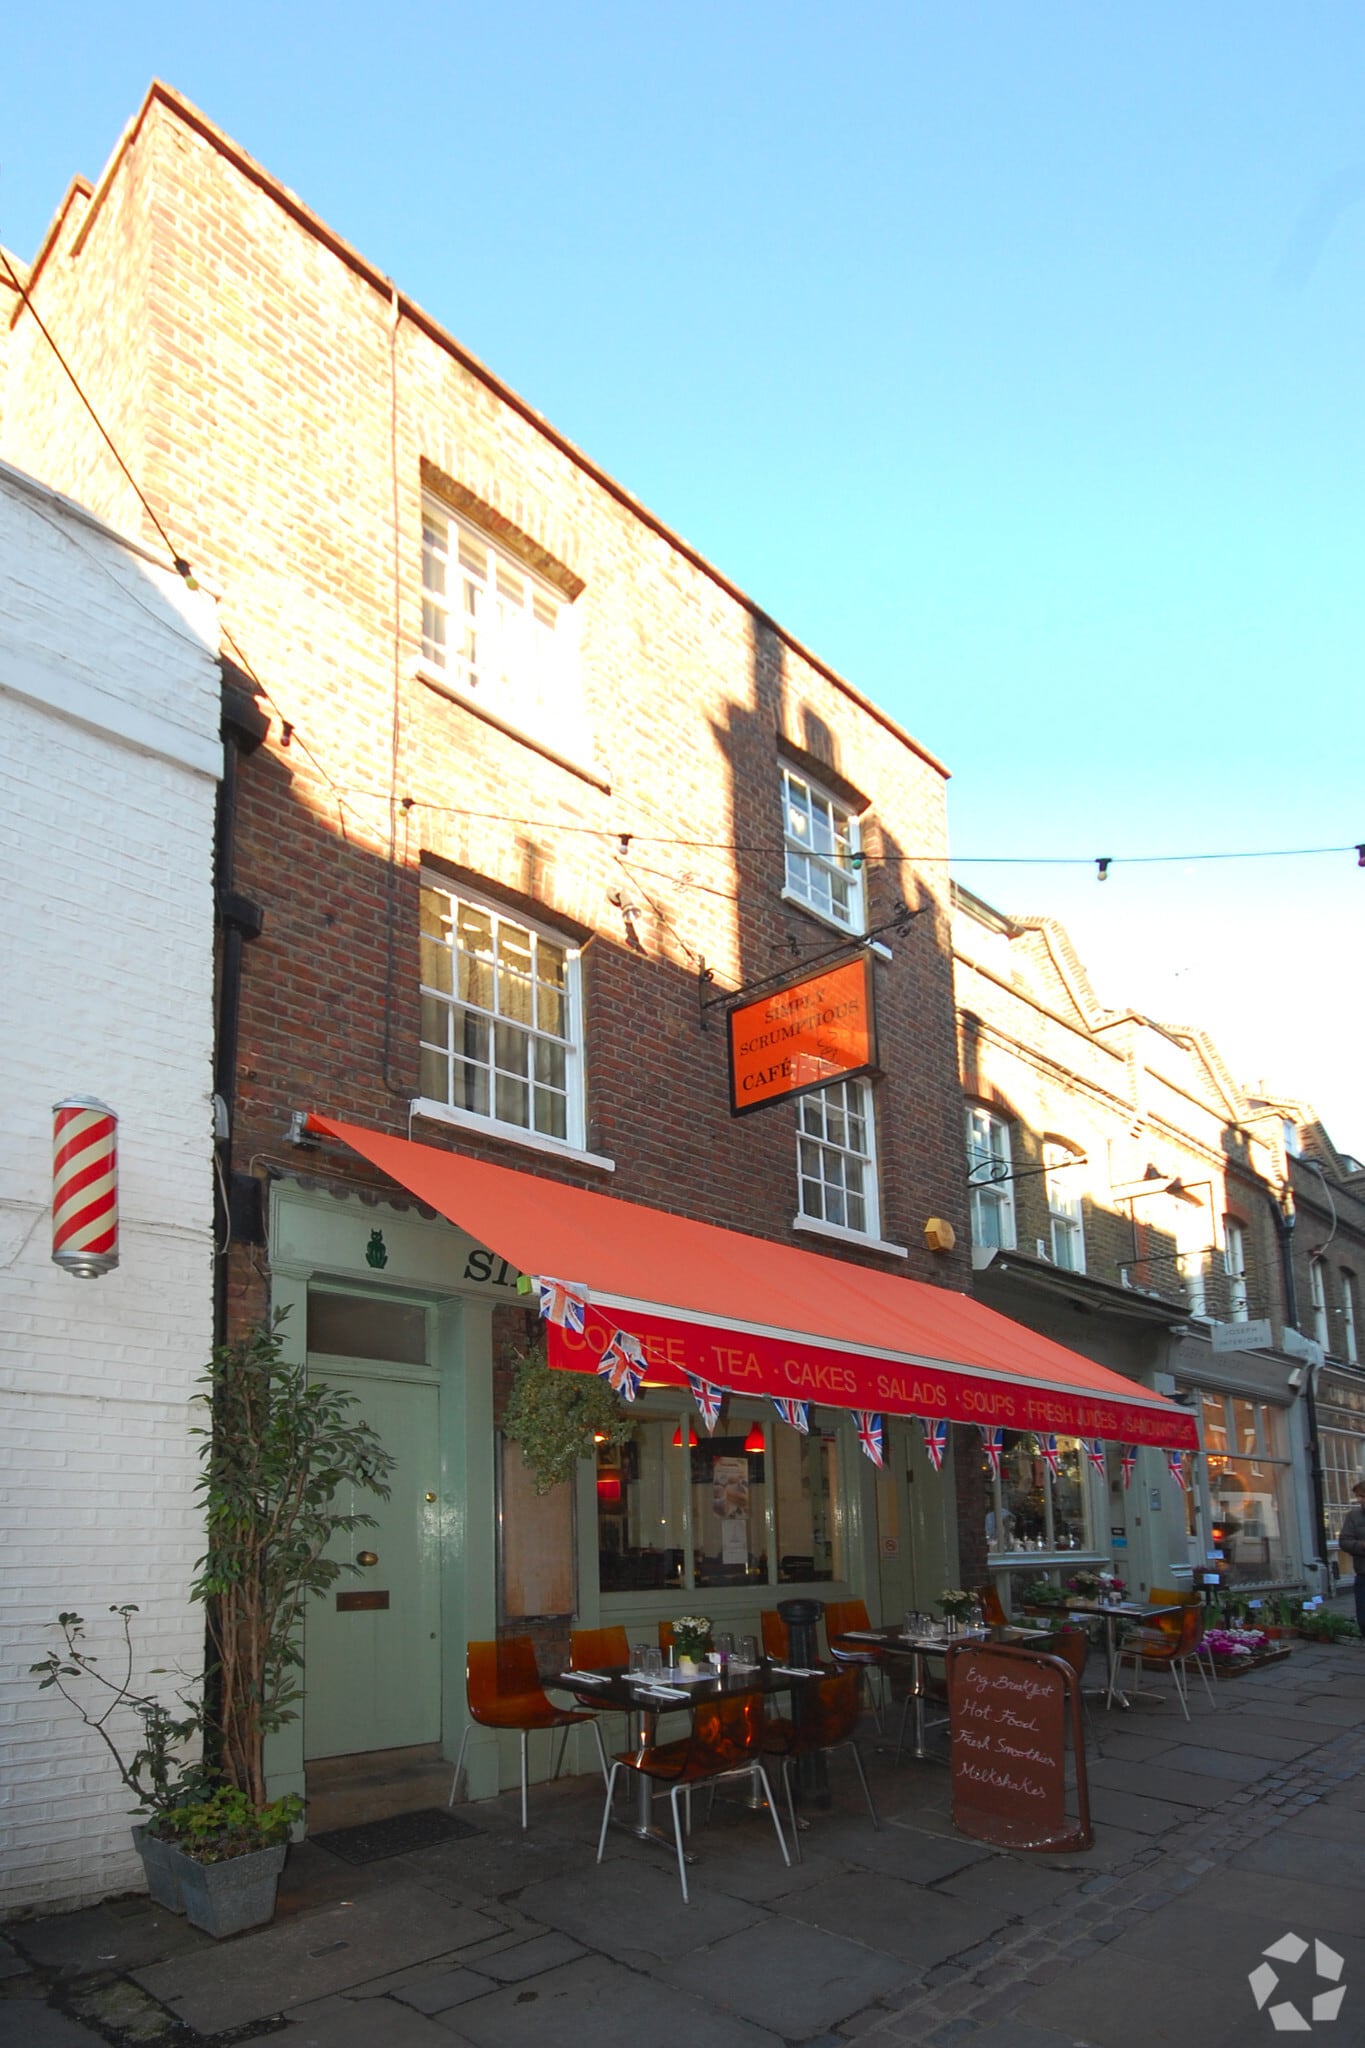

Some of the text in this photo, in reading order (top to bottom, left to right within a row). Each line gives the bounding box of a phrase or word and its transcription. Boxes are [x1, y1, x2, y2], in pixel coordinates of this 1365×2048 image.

[765, 989, 825, 1024] SIMPLY
[740, 1001, 858, 1056] SCRUMPTIOUS
[743, 1058, 792, 1090] CAFÉ
[463, 1249, 523, 1287] SI
[562, 1325, 685, 1366] COEE
[711, 1346, 763, 1379] TEA
[785, 1360, 857, 1393] CAKES
[877, 1375, 946, 1406] SALADS
[963, 1390, 1015, 1416] SOUPS
[1027, 1400, 1073, 1425] FRESH
[1077, 1408, 1118, 1430] JUICES
[960, 1699, 1040, 1731] Hot Food
[954, 1729, 990, 1751] Fresh
[956, 1762, 1046, 1798] Milkshakes
